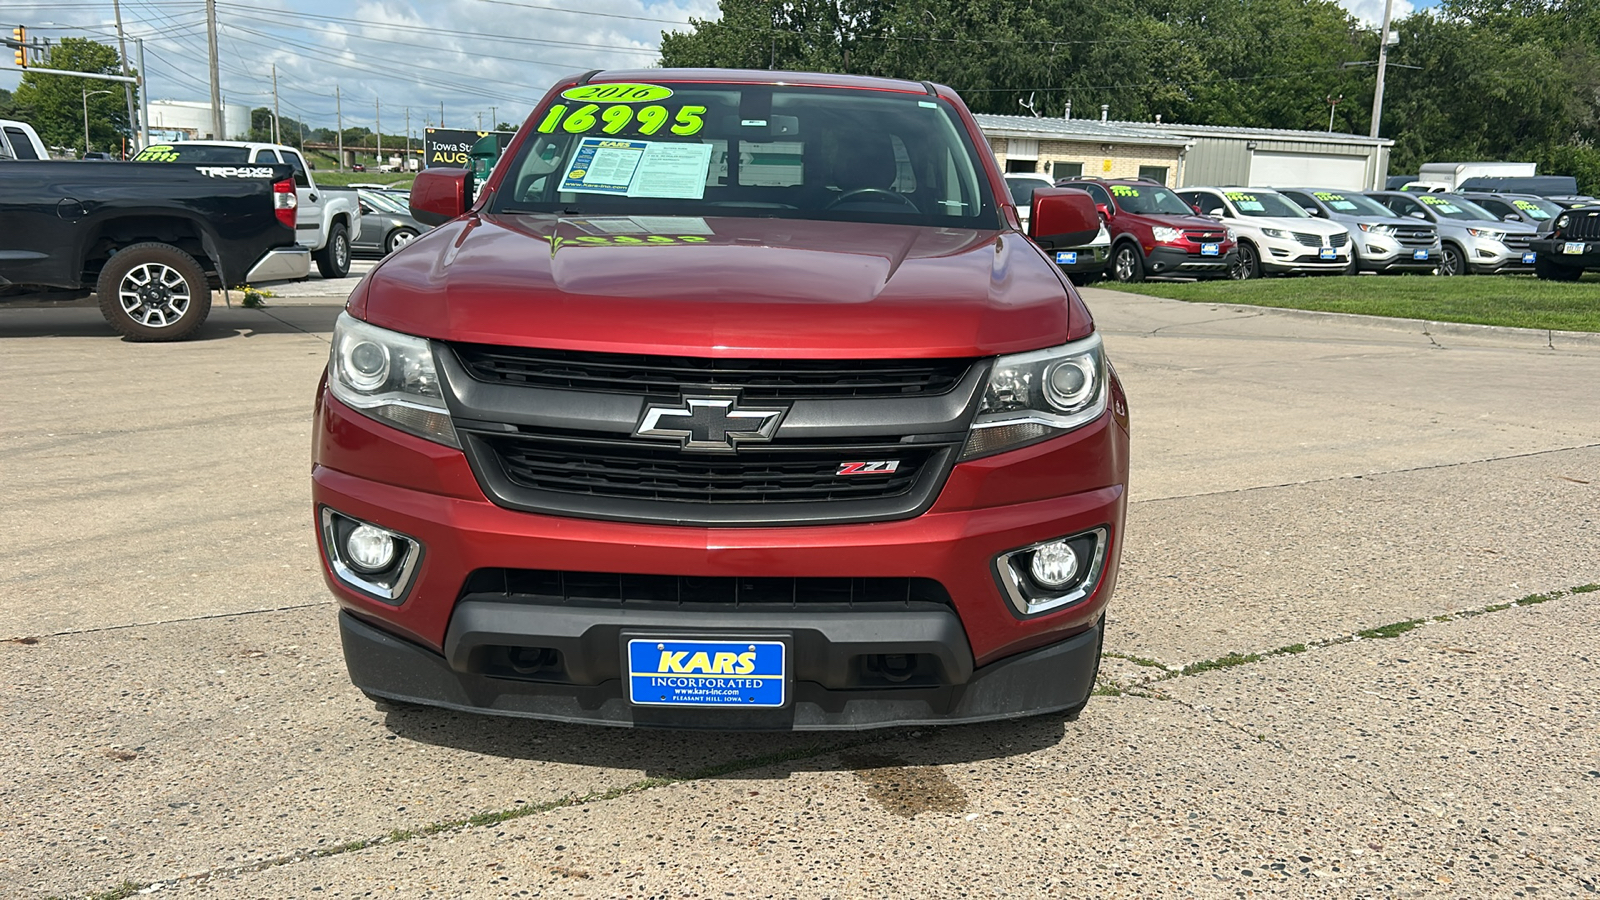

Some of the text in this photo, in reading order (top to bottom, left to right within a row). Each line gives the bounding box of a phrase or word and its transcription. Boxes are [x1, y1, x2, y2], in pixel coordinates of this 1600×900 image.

[578, 86, 650, 100] 2016
[537, 104, 707, 136] 16995
[432, 141, 458, 151] Iowa
[135, 152, 181, 163] 12995
[836, 460, 900, 476] Z71
[657, 651, 757, 675] KARS
[651, 677, 763, 688] INCORPORATED
[674, 687, 740, 696] www.kars-inc.com
